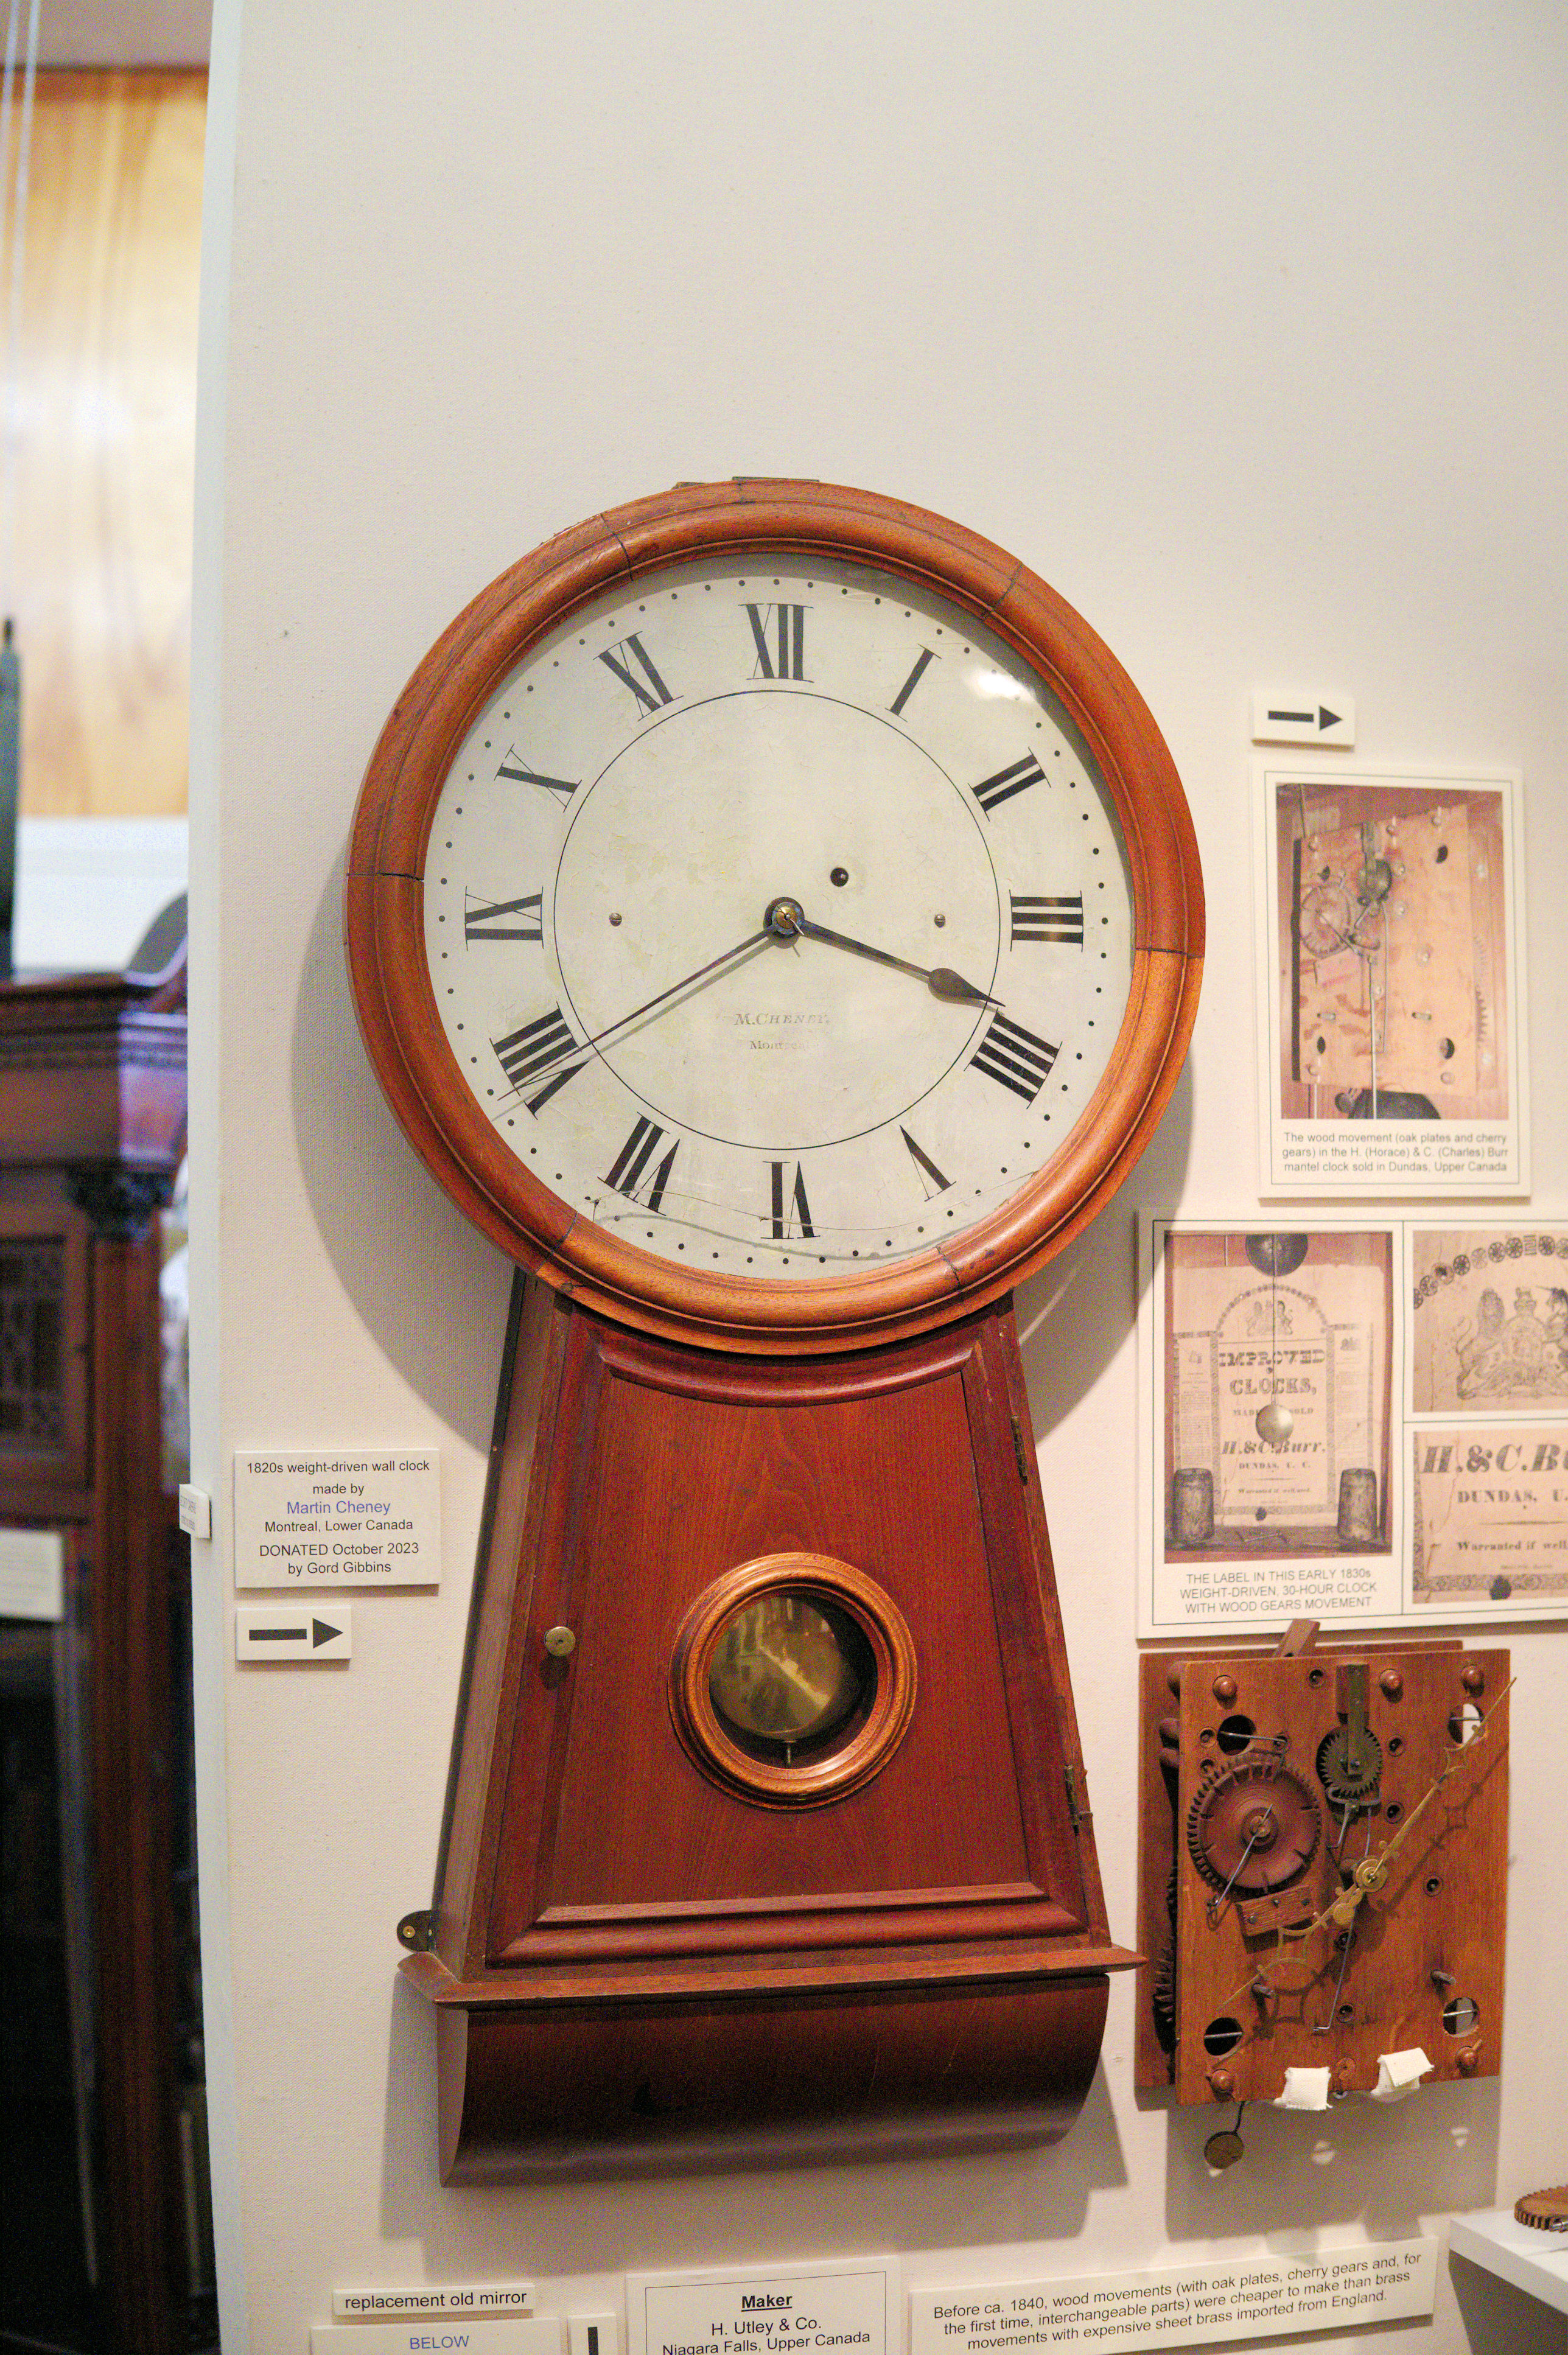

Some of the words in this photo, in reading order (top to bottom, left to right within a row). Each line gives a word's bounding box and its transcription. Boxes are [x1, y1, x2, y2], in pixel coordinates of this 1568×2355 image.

[740, 602, 814, 683] XII
[593, 631, 684, 722] XI
[886, 644, 941, 722] I
[494, 744, 581, 813] X
[968, 747, 1051, 821] II
[464, 886, 544, 952] IX
[1009, 889, 1084, 952] III
[965, 1006, 1063, 1108] IIII
[1284, 1133, 1303, 1142] The
[1307, 1133, 1335, 1142] wood
[1339, 1133, 1391, 1142] movement
[1396, 1133, 1416, 1144] (oak
[1421, 1133, 1451, 1144] plates
[1455, 1133, 1472, 1142] and
[1476, 1133, 1507, 1144] cherry
[1283, 1148, 1315, 1158] gears)
[1319, 1148, 1328, 1157] in
[1331, 1147, 1346, 1157] the
[1351, 1148, 1360, 1157] H.
[1365, 1147, 1410, 1158] (Horace)
[1413, 1148, 1420, 1157] &
[1424, 1148, 1434, 1157] C.
[1438, 1147, 1485, 1159] (Charles)
[1488, 1148, 1508, 1157] Burr
[598, 1111, 680, 1216] VII
[900, 1124, 956, 1202] V
[1284, 1163, 1319, 1172] mantel
[1323, 1162, 1348, 1172] clock
[1353, 1162, 1373, 1172] sold
[1376, 1162, 1385, 1171] in
[1388, 1162, 1430, 1173] Dundas,
[1434, 1163, 1465, 1174] Upper
[1468, 1163, 1507, 1172] Canada
[762, 1160, 821, 1239] VI
[1219, 1349, 1325, 1367] IMPROVED
[1230, 1377, 1317, 1395] CLOCKS,
[247, 1462, 283, 1473] 1820s
[287, 1461, 368, 1475] weight-driven
[372, 1461, 395, 1471] wall
[399, 1460, 430, 1471] clock
[313, 1484, 346, 1494] made
[351, 1483, 364, 1496] by
[287, 1502, 331, 1514] Martin
[336, 1500, 390, 1515] Cheney
[265, 1521, 321, 1532] Montreal,
[326, 1520, 362, 1531] Lower
[366, 1519, 413, 1530] Canada
[260, 1544, 328, 1556] DONATED
[333, 1544, 383, 1555] October
[388, 1542, 419, 1553] 2023
[1457, 1541, 1521, 1550] Warranted
[1527, 1541, 1536, 1550] if
[288, 1563, 303, 1576] by
[307, 1562, 338, 1573] Gord
[343, 1561, 391, 1573] Gibbins
[1186, 1573, 1209, 1584] THE
[1214, 1573, 1250, 1583] LABEL
[1254, 1572, 1265, 1581] IN
[1269, 1570, 1295, 1581] THIS
[1298, 1569, 1336, 1580] EARLY
[1341, 1568, 1371, 1578] 1830s
[1180, 1586, 1279, 1599] WEIGHT-DRIVEN,
[1283, 1584, 1333, 1595] 30-HOUR
[1337, 1583, 1377, 1593] CLOCK
[1186, 1603, 1215, 1613] WITH
[1220, 1601, 1257, 1612] WOOD
[1261, 1600, 1301, 1611] GEARS
[1305, 1597, 1372, 1609] MOVEMENT
[934, 2304, 979, 2318] Before
[984, 2304, 1004, 2314] ca.
[1010, 2297, 1047, 2312] 1840,
[1052, 2293, 1089, 2308] wood
[1094, 2283, 1171, 2303] movements
[1177, 2280, 1207, 2297] (with
[1212, 2276, 1235, 2289] oak
[1240, 2272, 1283, 2289] plates,
[1287, 2267, 1328, 2281] cherry
[1332, 2261, 1368, 2278] gears
[1373, 2256, 1399, 2269] and,
[1404, 2253, 1421, 2265] for
[345, 2294, 444, 2311] replacement
[450, 2292, 474, 2305] old
[480, 2292, 527, 2304] mirror
[741, 2294, 792, 2309] Maker
[945, 2323, 965, 2335] the
[970, 2318, 995, 2332] first
[1000, 2314, 1033, 2329] time,
[1038, 2303, 1147, 2326] interchangeable
[1152, 2298, 1189, 2315] parts)
[1195, 2297, 1226, 2309] were
[1231, 2289, 1284, 2306] cheaper
[1287, 2286, 1300, 2297] to
[1304, 2281, 1339, 2295] make
[1344, 2277, 1371, 2290] than
[1376, 2272, 1410, 2285] brass
[712, 2323, 727, 2336] H.
[735, 2320, 773, 2336] Utley
[779, 2319, 789, 2331] &
[796, 2317, 821, 2330] Co.
[968, 2332, 1047, 2350] movements
[1052, 2327, 1078, 2340] with
[1084, 2322, 1150, 2339] expensive
[1156, 2315, 1191, 2329] sheet
[1197, 2311, 1232, 2325] brass
[1237, 2302, 1293, 2321] imported
[1298, 2300, 1326, 2312] from
[1332, 2290, 1387, 2309] England.
[410, 2336, 469, 2350] BELOW
[663, 2342, 718, 2355] Niagara
[724, 2340, 761, 2353] Falls,
[768, 2336, 810, 2351] Upper
[815, 2331, 870, 2347] Canada
